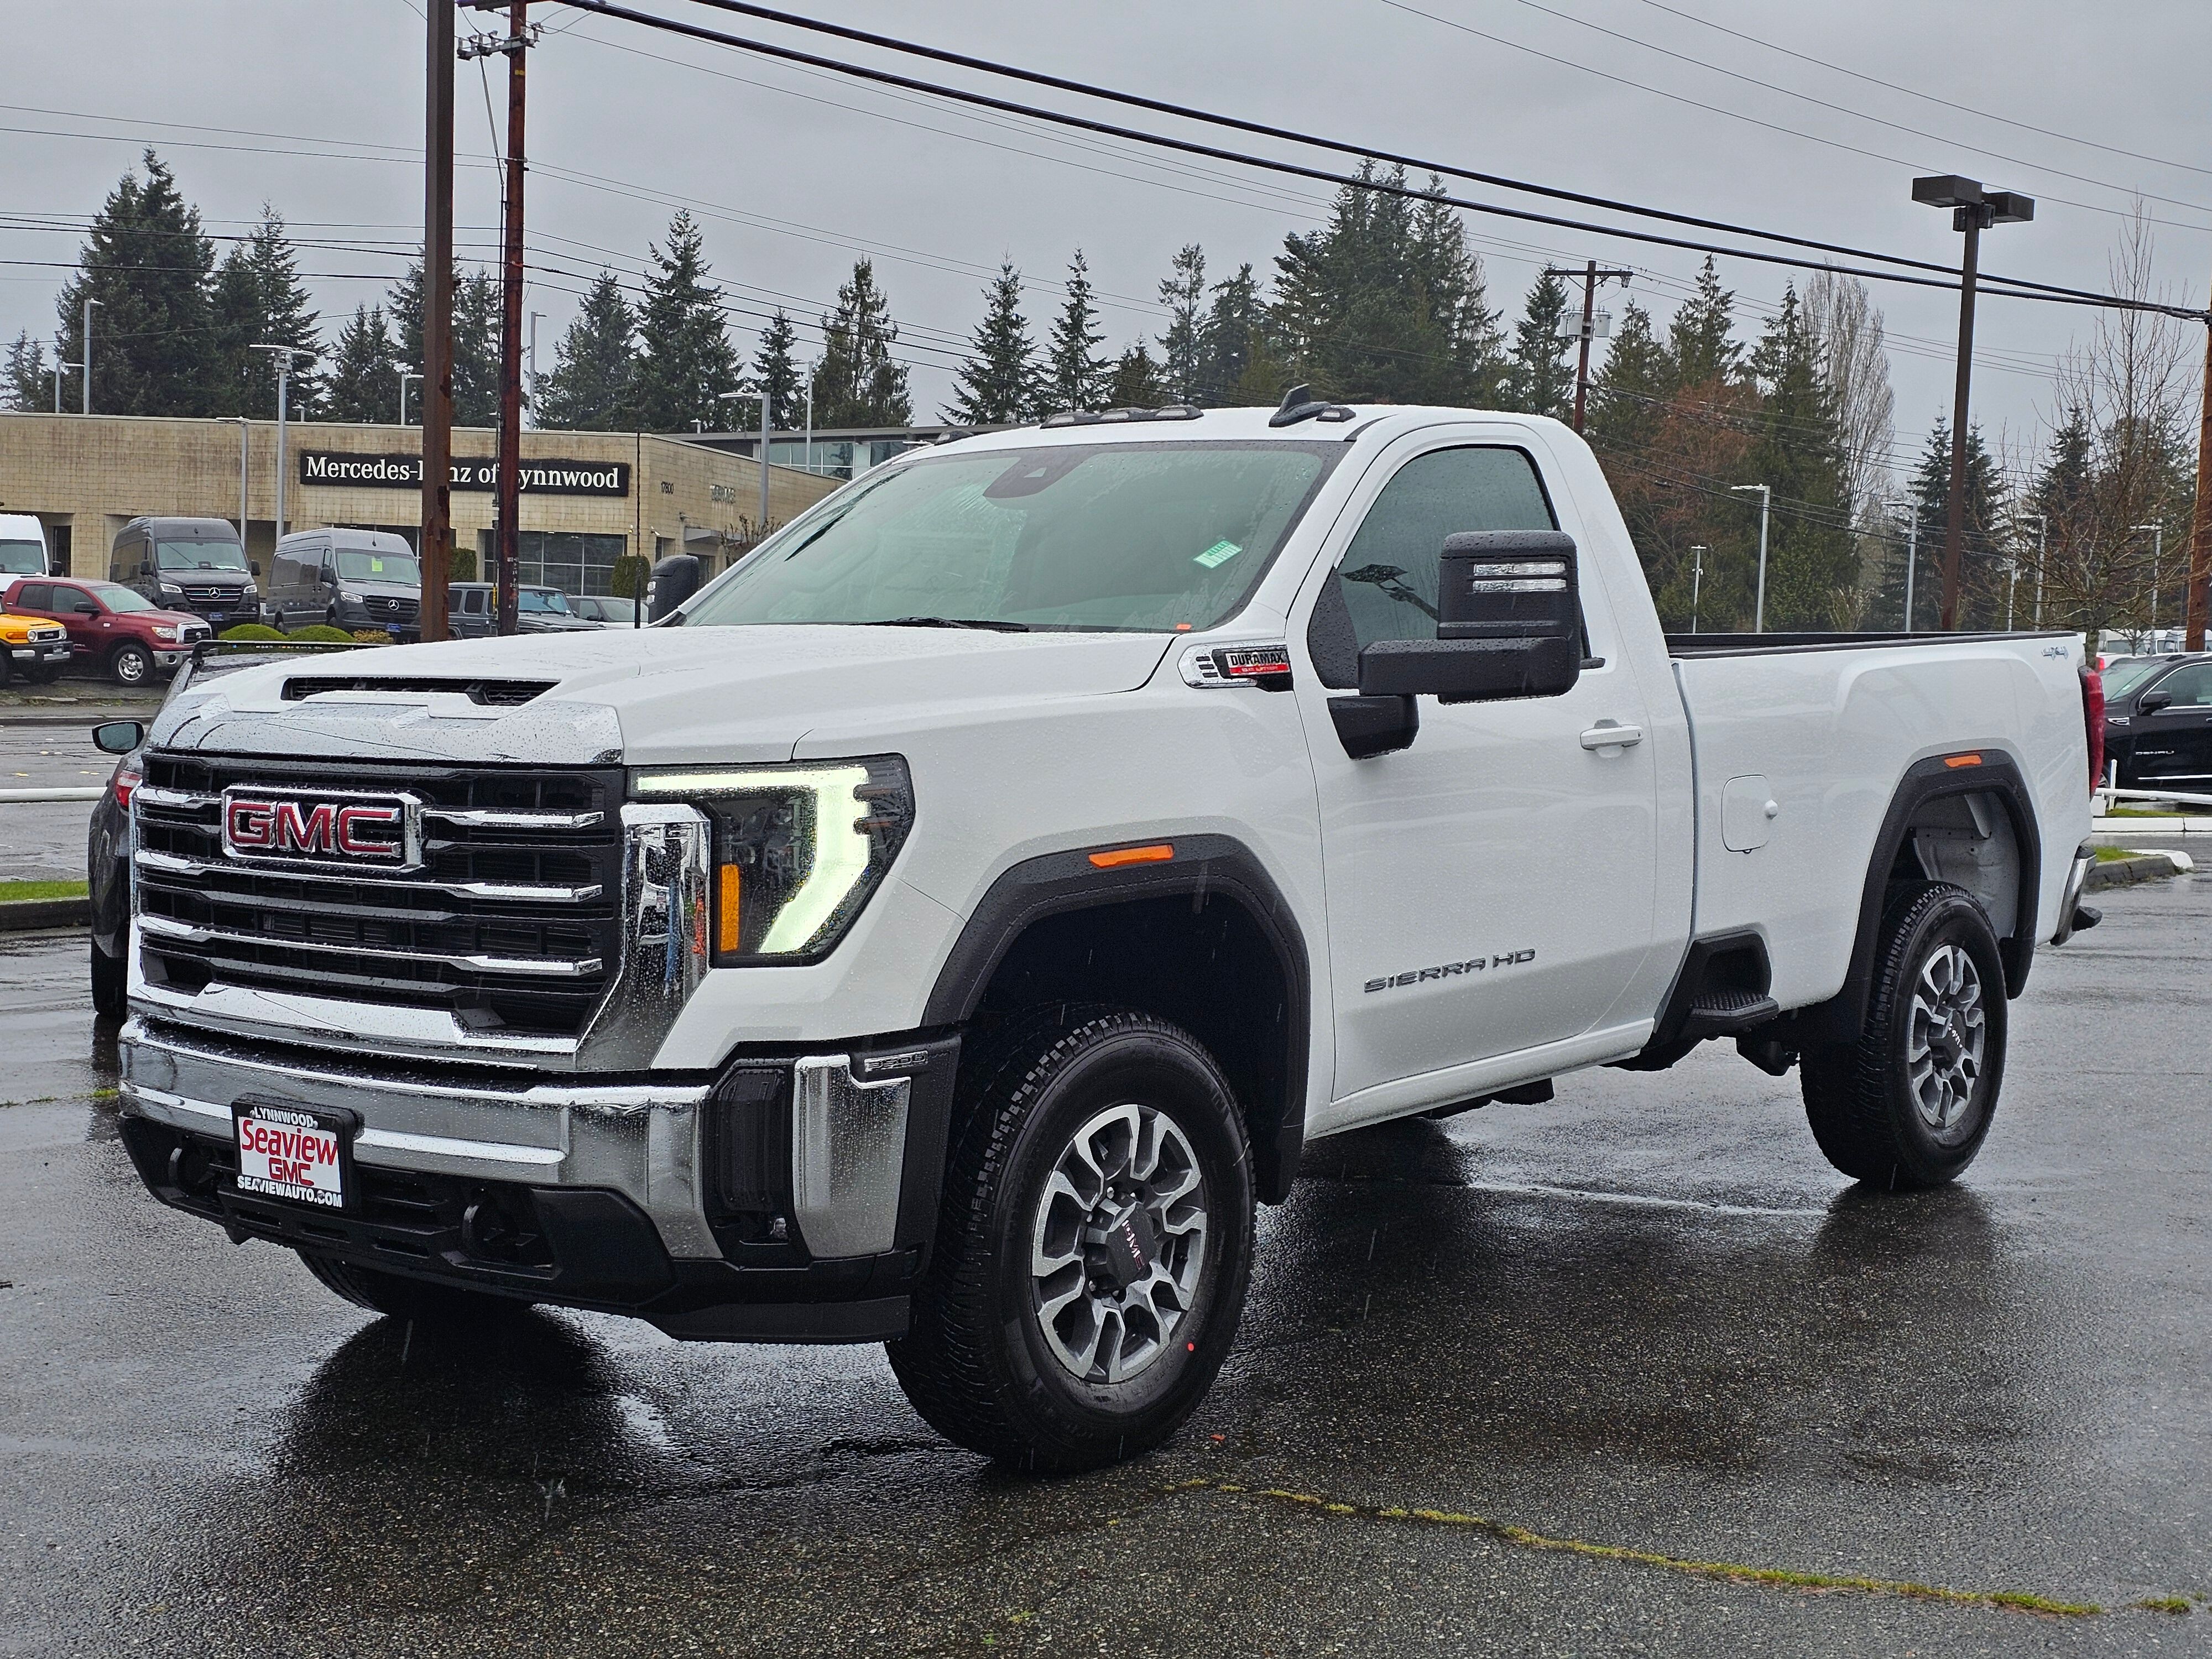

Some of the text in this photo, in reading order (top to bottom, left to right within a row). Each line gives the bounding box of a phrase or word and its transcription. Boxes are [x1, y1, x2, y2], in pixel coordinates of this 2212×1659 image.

[306, 456, 471, 483] Mercedes-nz
[518, 468, 619, 489] ynnwood
[1230, 653, 1284, 666] DURAMAX
[228, 800, 401, 858] GMC
[1364, 948, 1535, 993] SIERRA HD
[254, 1106, 314, 1128] LYNNWOOD
[242, 1119, 338, 1166] Seaview
[268, 1157, 315, 1187] GMC
